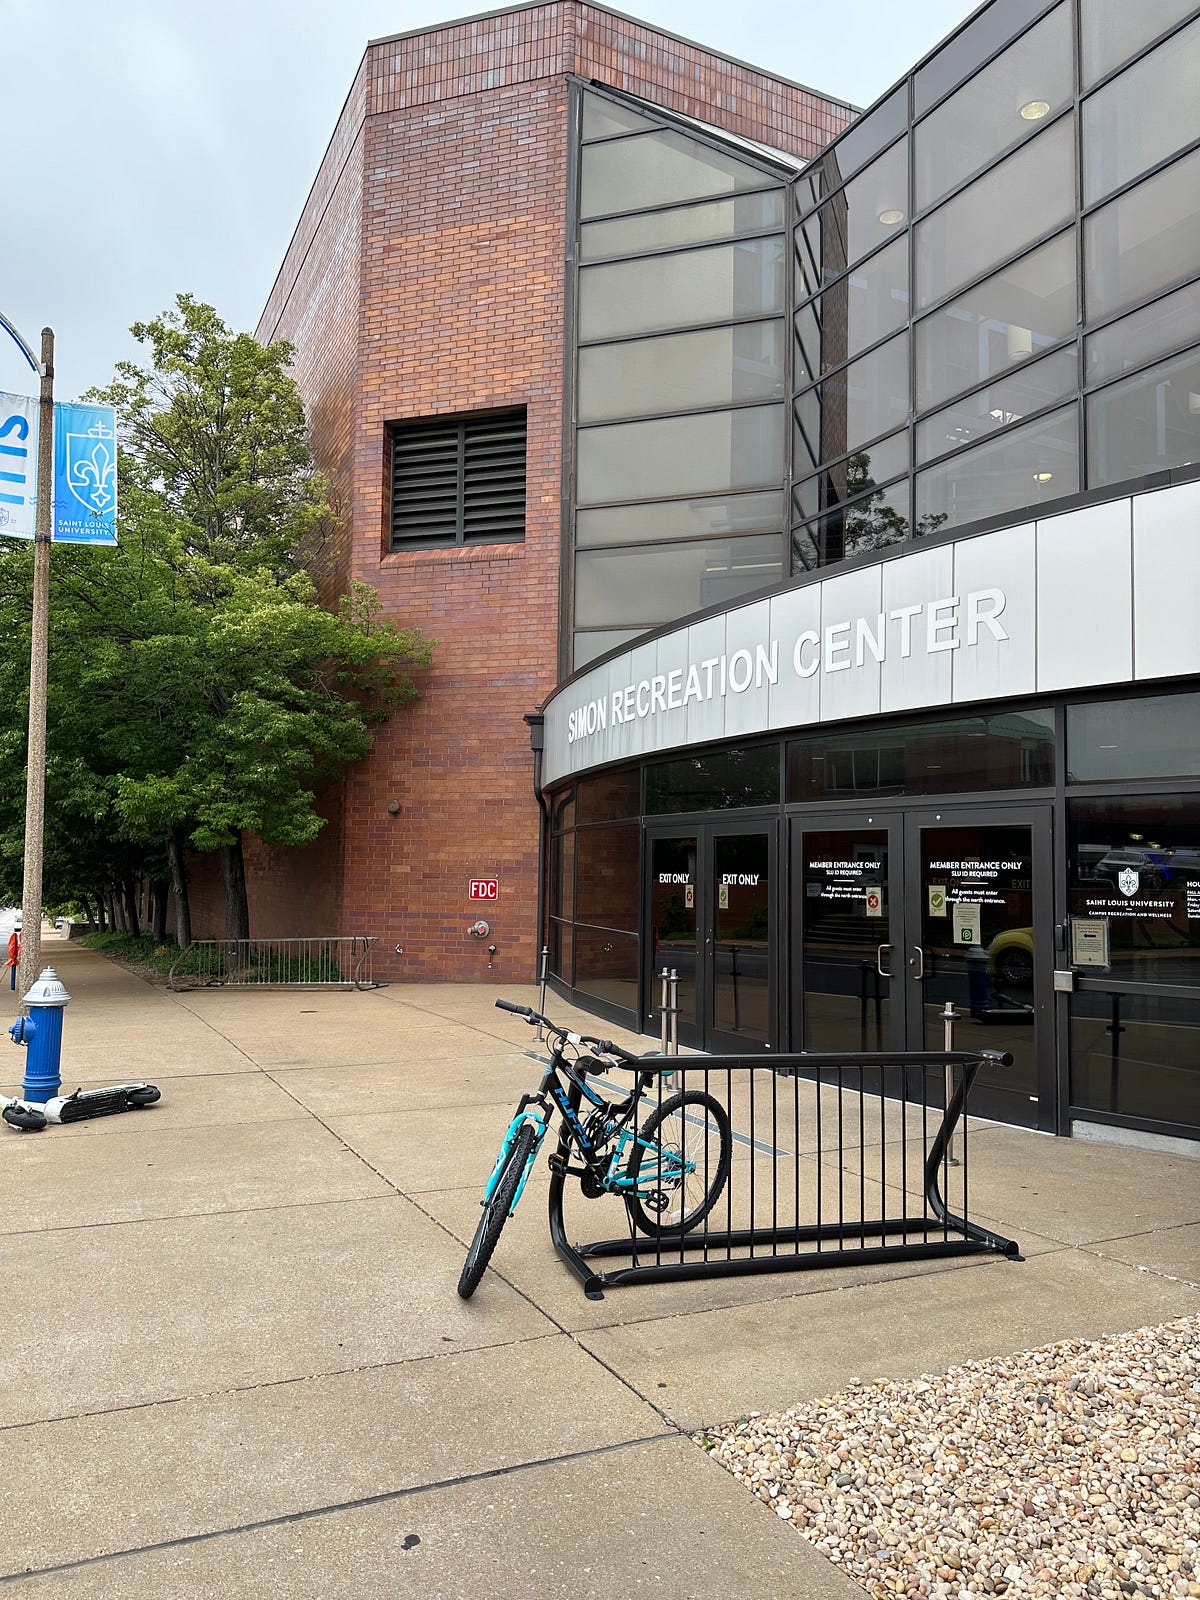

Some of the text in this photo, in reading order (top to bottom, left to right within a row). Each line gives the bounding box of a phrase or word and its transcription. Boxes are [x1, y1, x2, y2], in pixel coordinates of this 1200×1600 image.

[568, 587, 1010, 744] SIMON RECREATION CENTER
[809, 861, 881, 869] MEMBER ENTRANCE ONLY
[929, 861, 1022, 870] MEMBER ENTRANCE ONLY
[659, 873, 690, 884] EXIT ONLY
[969, 870, 998, 878] REQUIRED
[722, 873, 760, 886] EXIT ONLY
[471, 881, 496, 897] FDC
[944, 895, 962, 904] through
[1130, 900, 1175, 908] UNIVERSITY
